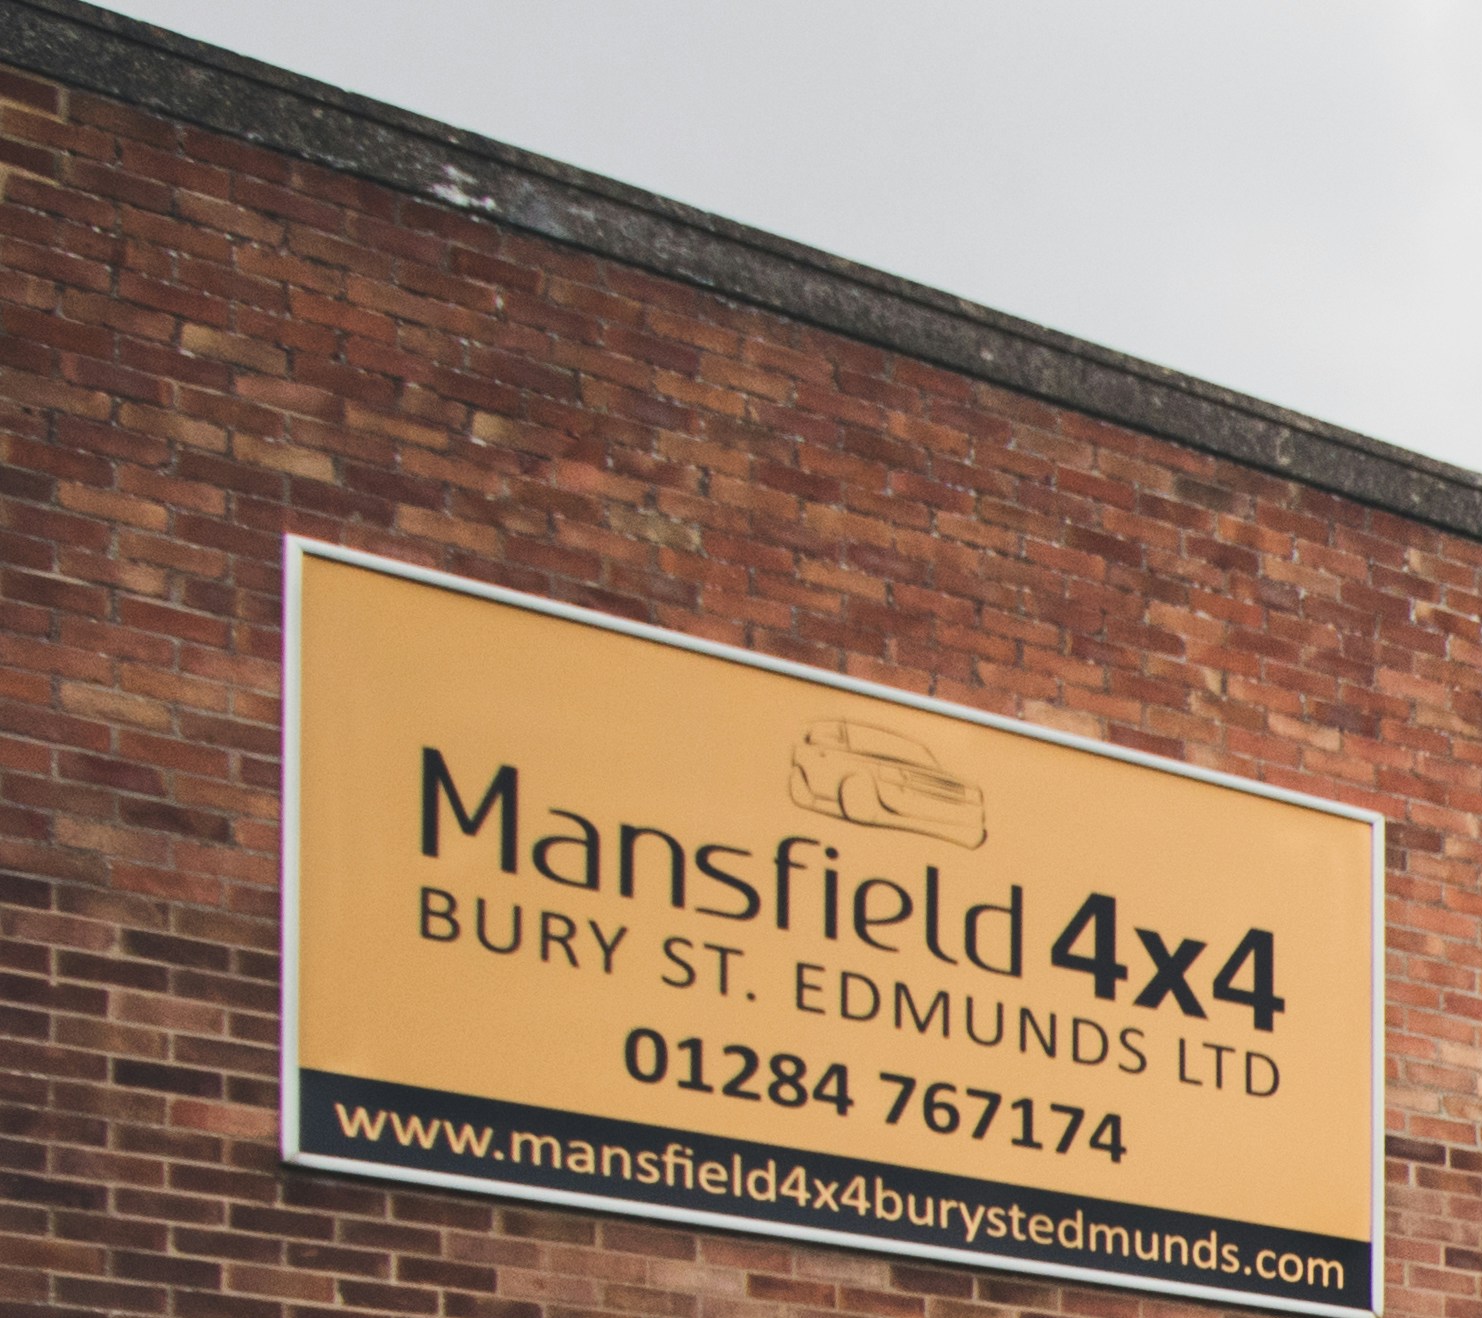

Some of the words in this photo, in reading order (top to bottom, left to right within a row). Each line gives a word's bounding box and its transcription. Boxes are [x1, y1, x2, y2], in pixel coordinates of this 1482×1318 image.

[420, 745, 1024, 979] Mansfield
[1050, 892, 1287, 1033] 4x4
[419, 885, 628, 974] BURY
[660, 936, 758, 1003] ST.
[795, 962, 1148, 1075] EDMUNDS
[1177, 1037, 1282, 1098] LTD
[624, 1027, 854, 1117] 01284
[879, 1072, 1127, 1163] 767174
[335, 1102, 1345, 1290] www.mansfield4x4burystedmunds.com
